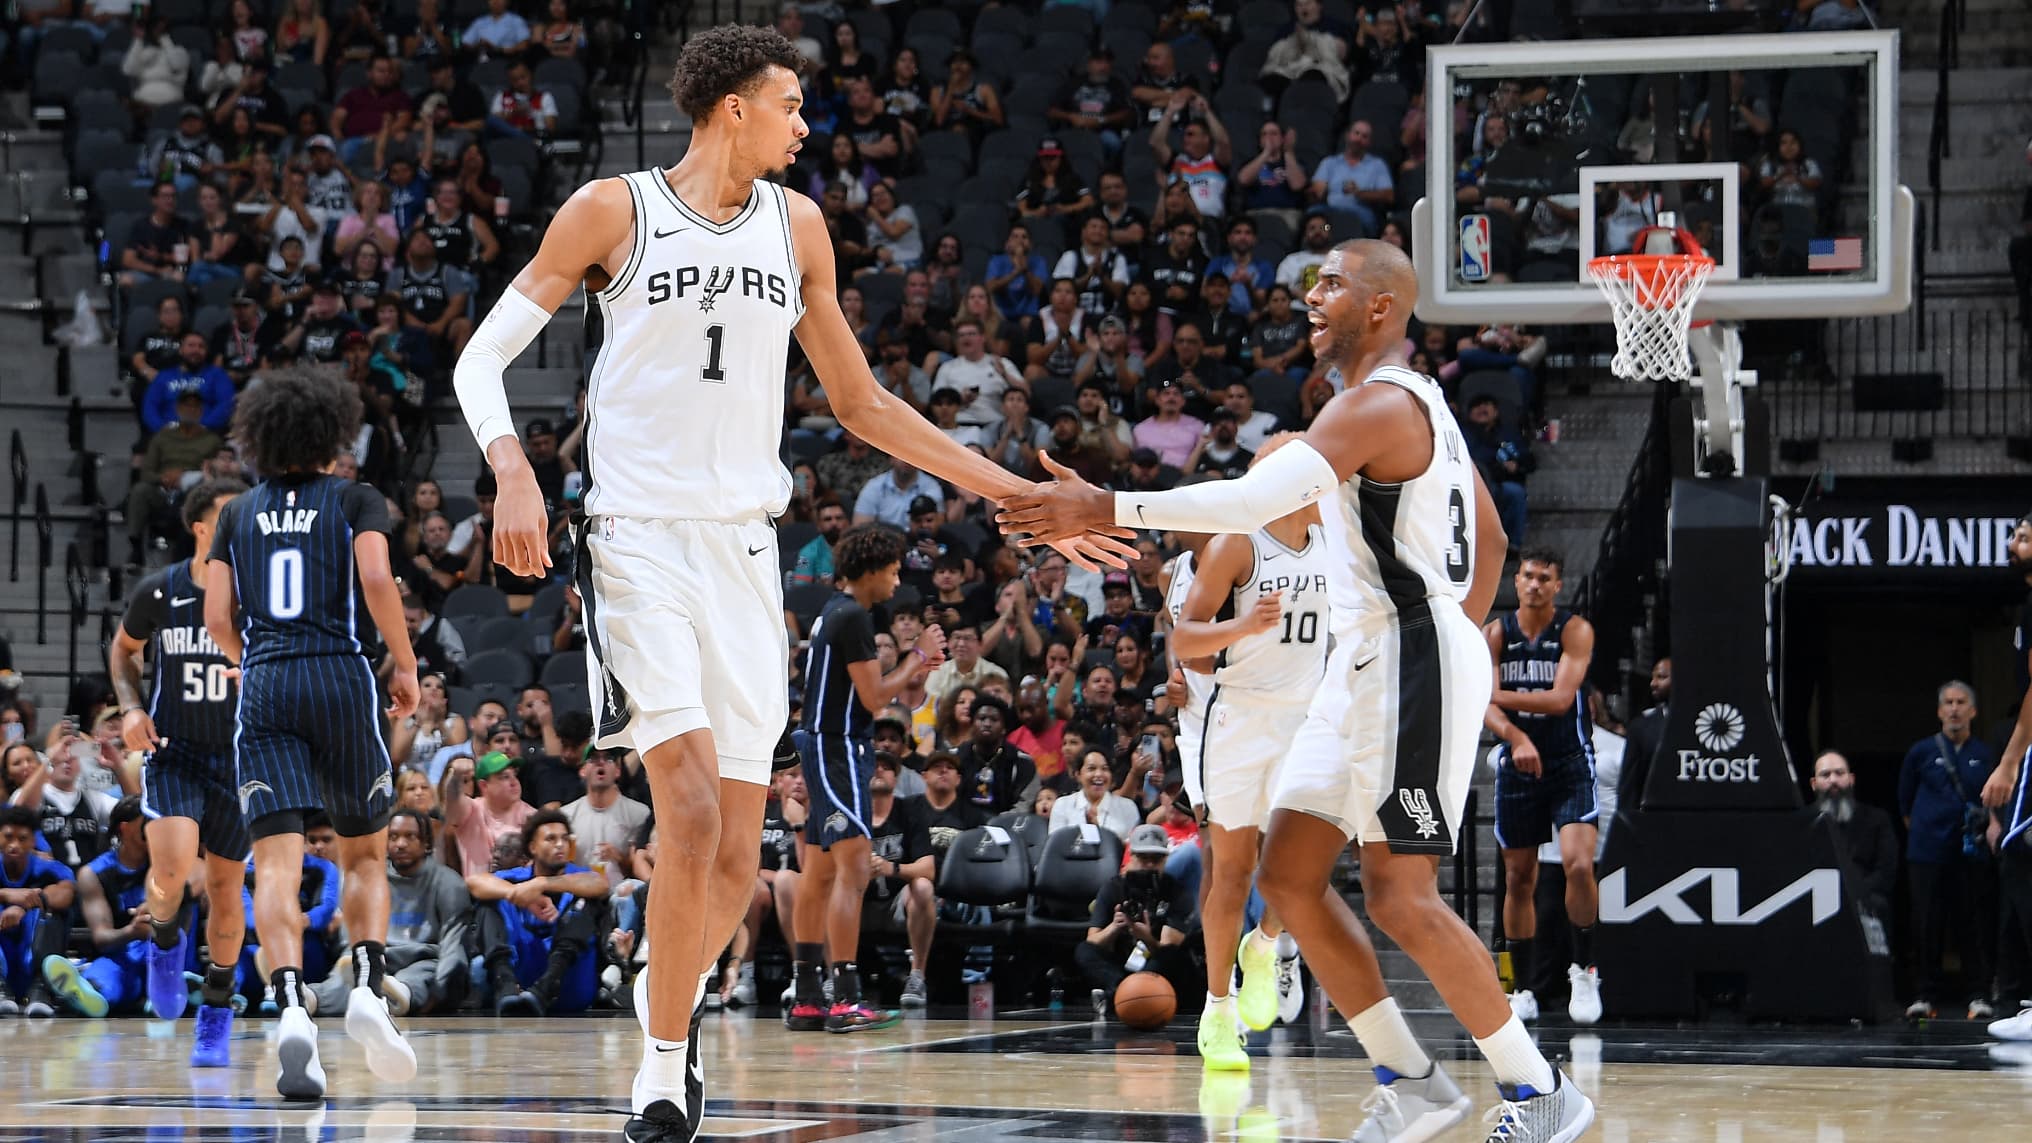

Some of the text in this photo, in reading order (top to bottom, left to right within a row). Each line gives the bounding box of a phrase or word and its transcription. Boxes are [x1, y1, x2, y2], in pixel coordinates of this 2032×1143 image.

[648, 266, 786, 314] SPURS
[699, 323, 727, 384] 1
[256, 509, 318, 536] BLACK
[1444, 484, 1469, 587] 3
[270, 549, 303, 619] 0
[1280, 611, 1318, 644] 10
[183, 662, 227, 701] 50
[1676, 750, 1760, 782] Frost
[65, 839, 81, 866] 1
[1598, 866, 1840, 927] KIA
